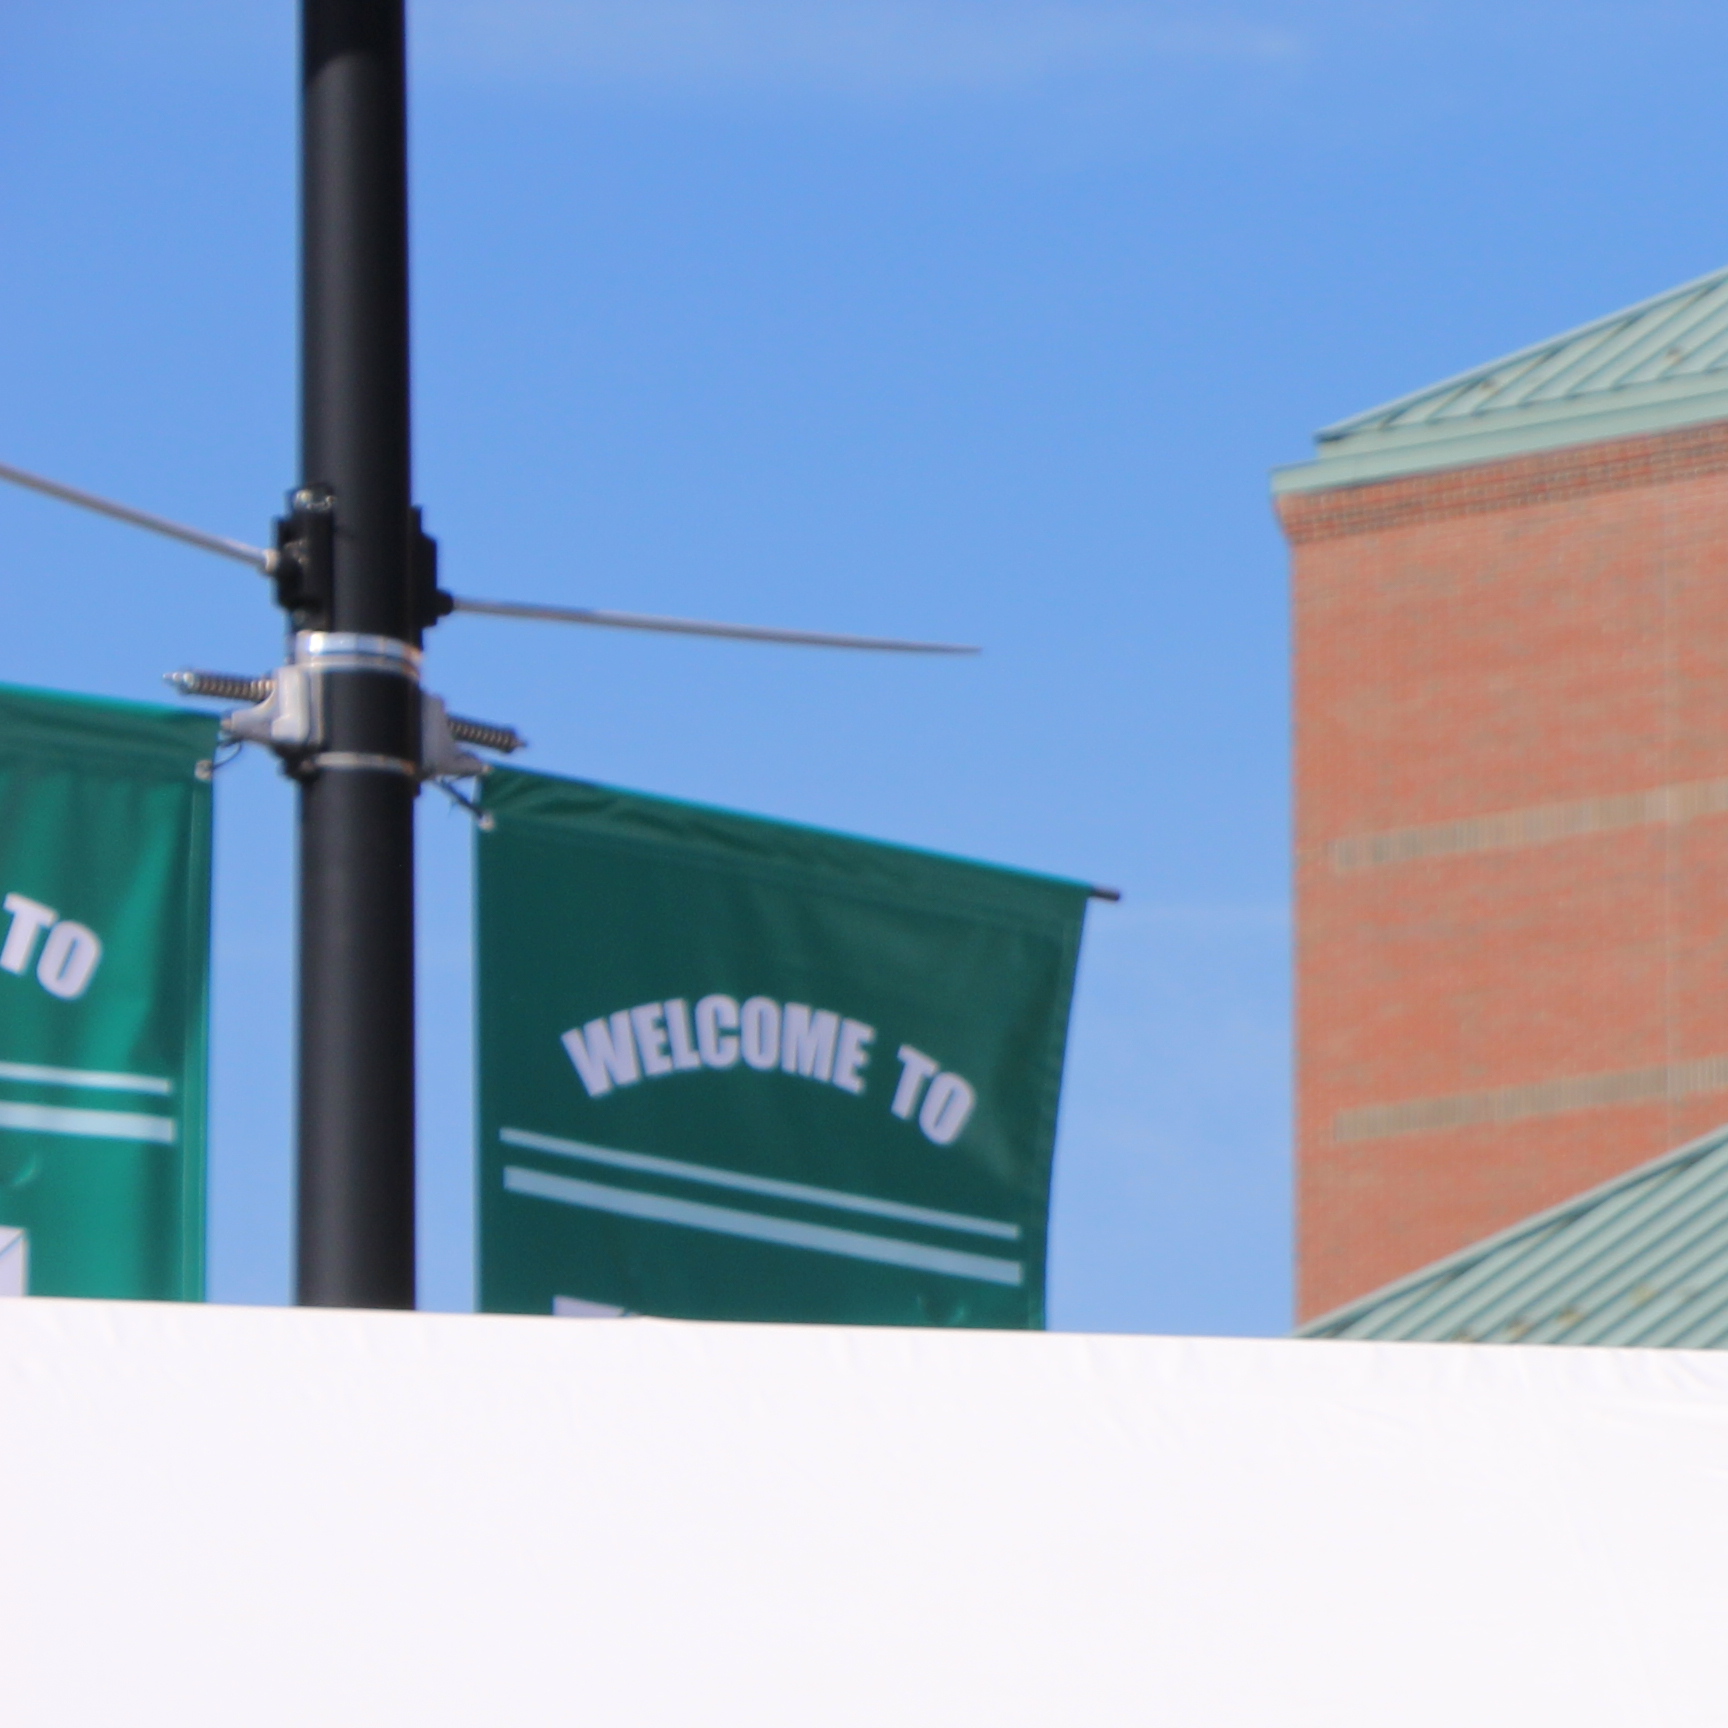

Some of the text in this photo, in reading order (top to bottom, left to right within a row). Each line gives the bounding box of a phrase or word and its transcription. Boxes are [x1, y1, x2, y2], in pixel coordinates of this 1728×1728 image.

[0, 893, 101, 998] TO
[562, 994, 976, 1145] WELCOME TO
